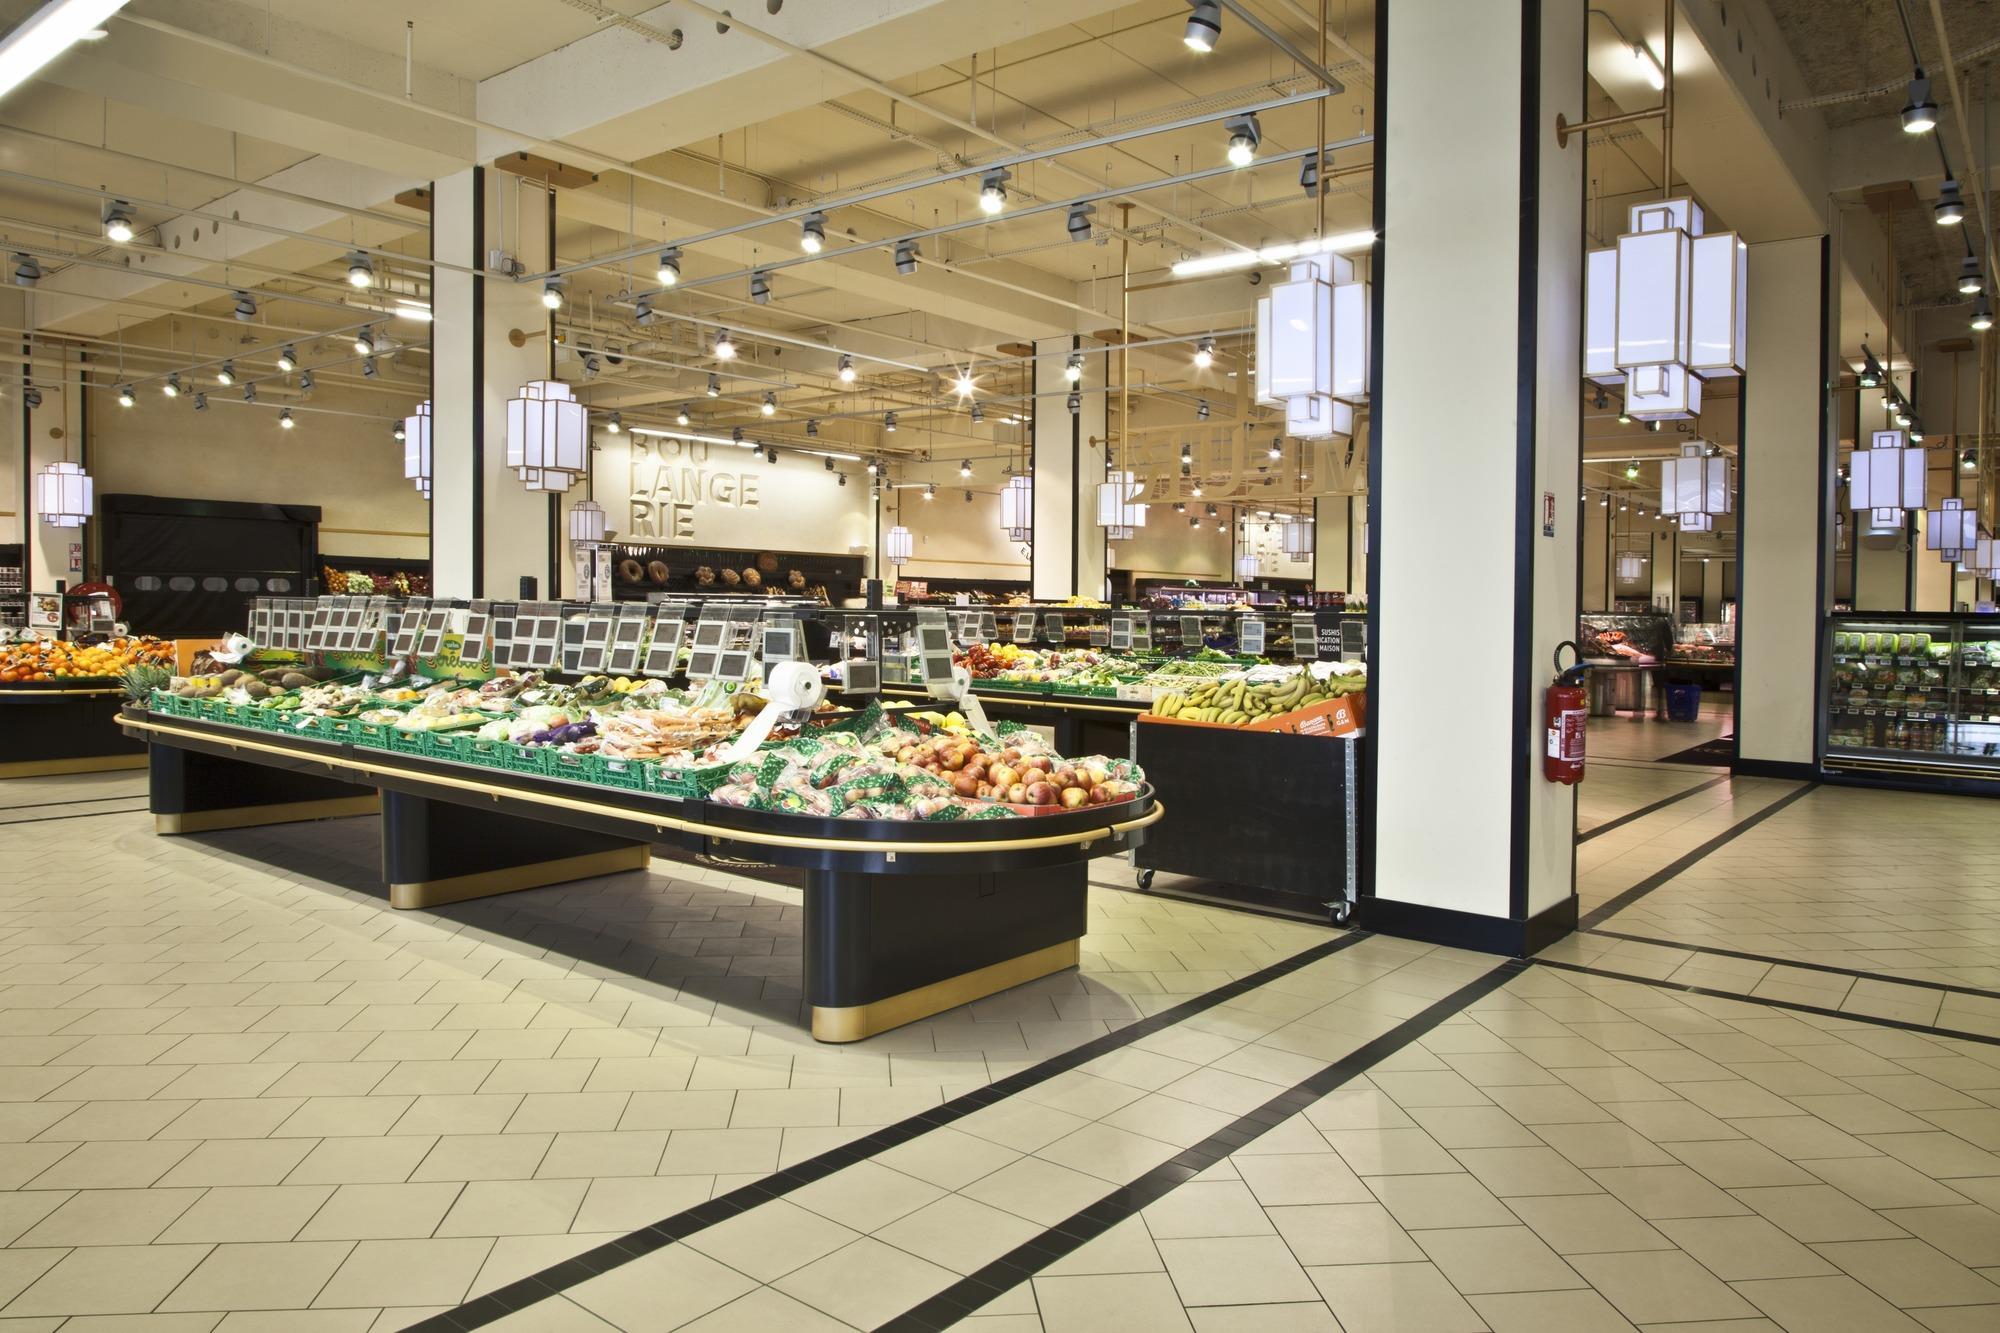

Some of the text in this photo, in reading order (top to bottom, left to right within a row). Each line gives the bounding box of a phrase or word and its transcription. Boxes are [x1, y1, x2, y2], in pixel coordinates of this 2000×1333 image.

[629, 431, 711, 465] BOU
[629, 462, 761, 510] LANGE
[629, 499, 696, 541] RIE
[1321, 628, 1340, 636] SUSHIS
